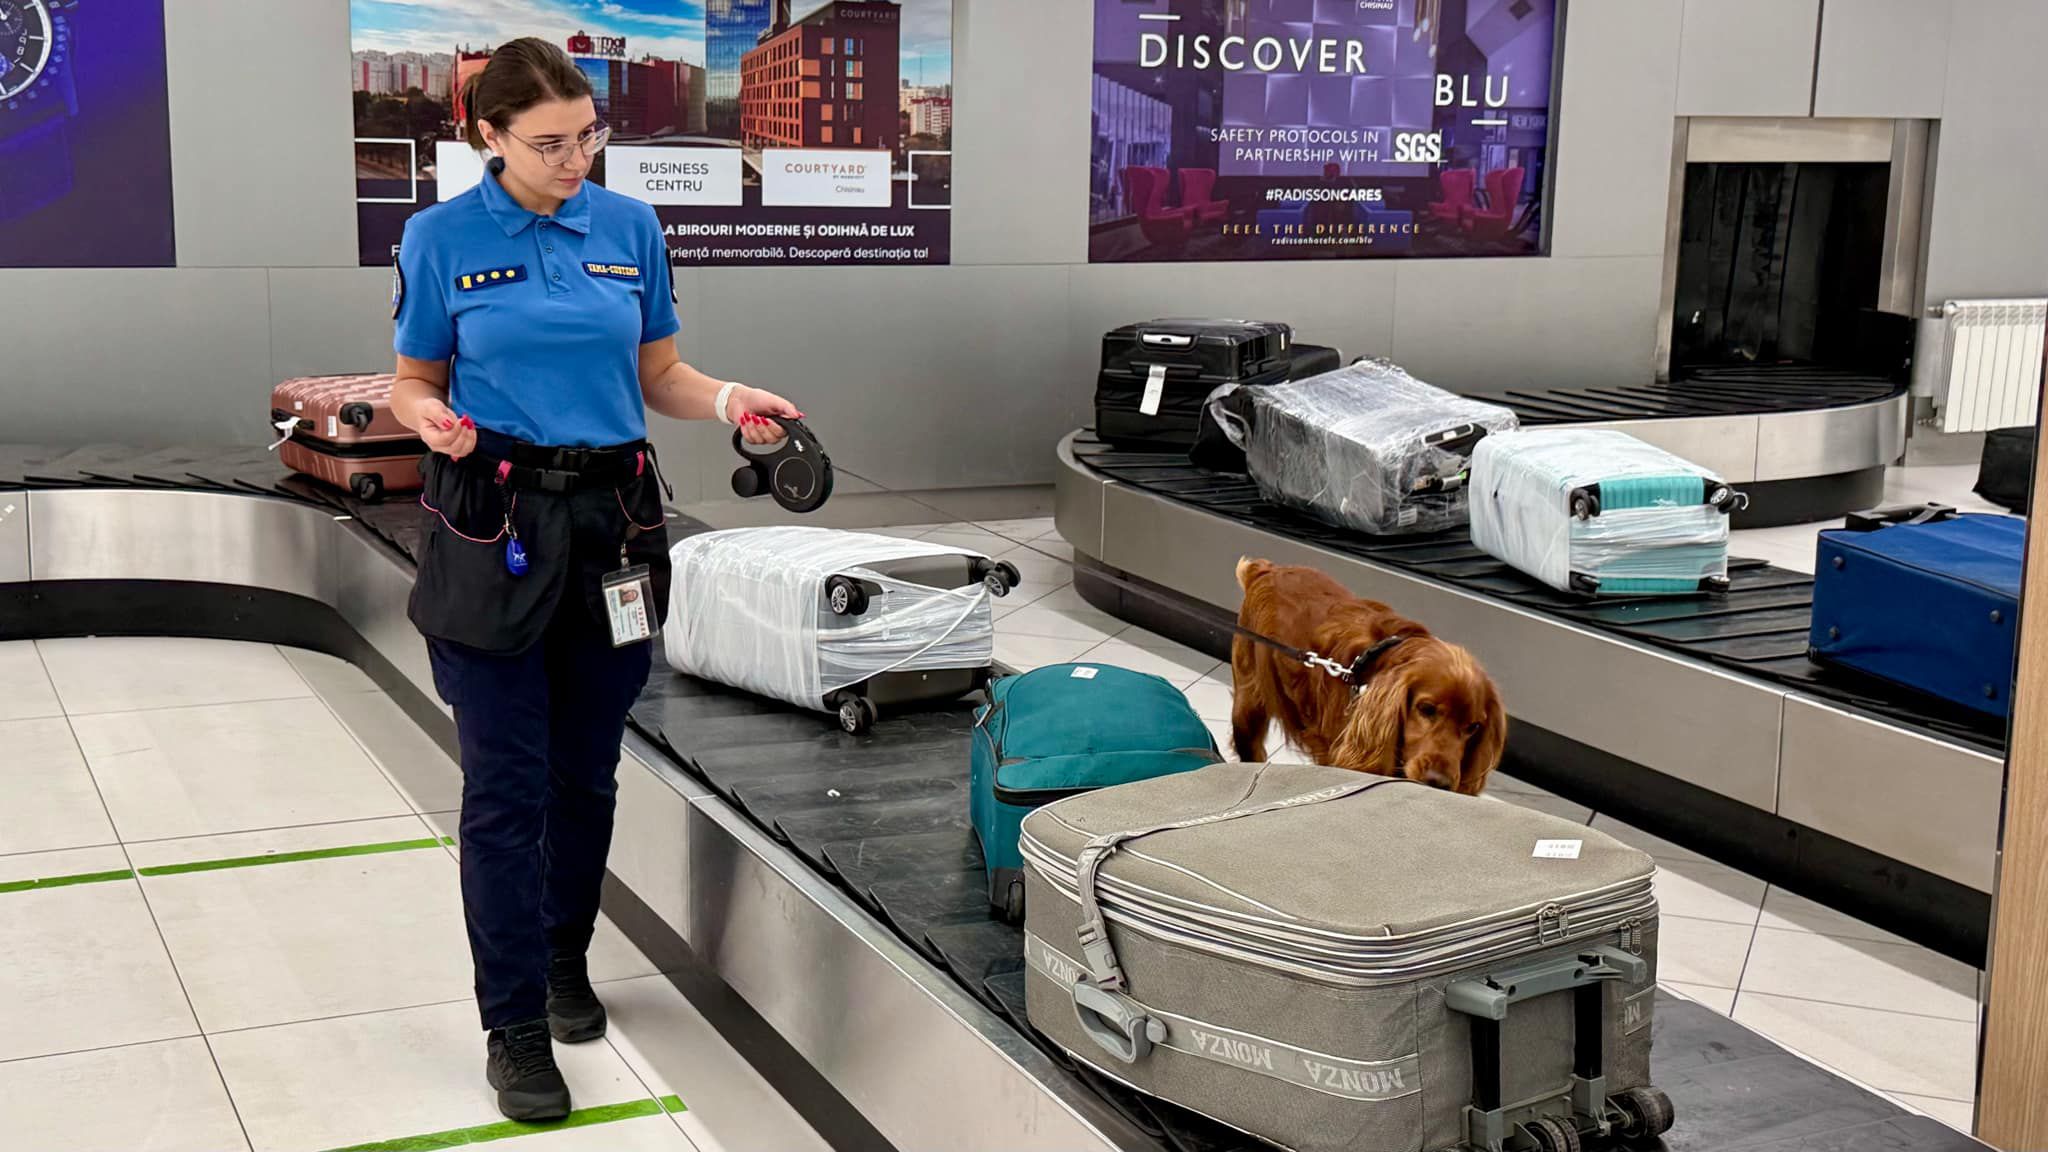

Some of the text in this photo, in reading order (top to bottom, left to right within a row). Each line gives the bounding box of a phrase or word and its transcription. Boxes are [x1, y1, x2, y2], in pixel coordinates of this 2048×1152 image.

[1140, 33, 1367, 73] DISCOVER
[1435, 74, 1509, 107] BLU
[1210, 128, 1379, 144] SAFETY PROTOCOLS IN
[1394, 132, 1441, 162] SGS
[1235, 148, 1378, 162] PARTNERSHIP WITH
[639, 162, 709, 175] BUSINESS
[785, 163, 865, 174] COURTYARD
[646, 179, 703, 192] CENTRU
[1266, 188, 1382, 201] #RADISSONCARES
[677, 224, 732, 236] BIROURI
[736, 224, 800, 236] MODERNE
[817, 222, 869, 236] ODIHNĂ
[871, 225, 888, 236] DE
[890, 225, 915, 236] LUX
[1222, 223, 1420, 235] FEEL THE DIFFERENCE
[712, 247, 786, 258] memorabilă.
[789, 246, 851, 260] Descoperă
[913, 247, 929, 258] ta!
[1191, 1028, 1274, 1071] MONZA
[1303, 1059, 1405, 1093] MONZA
